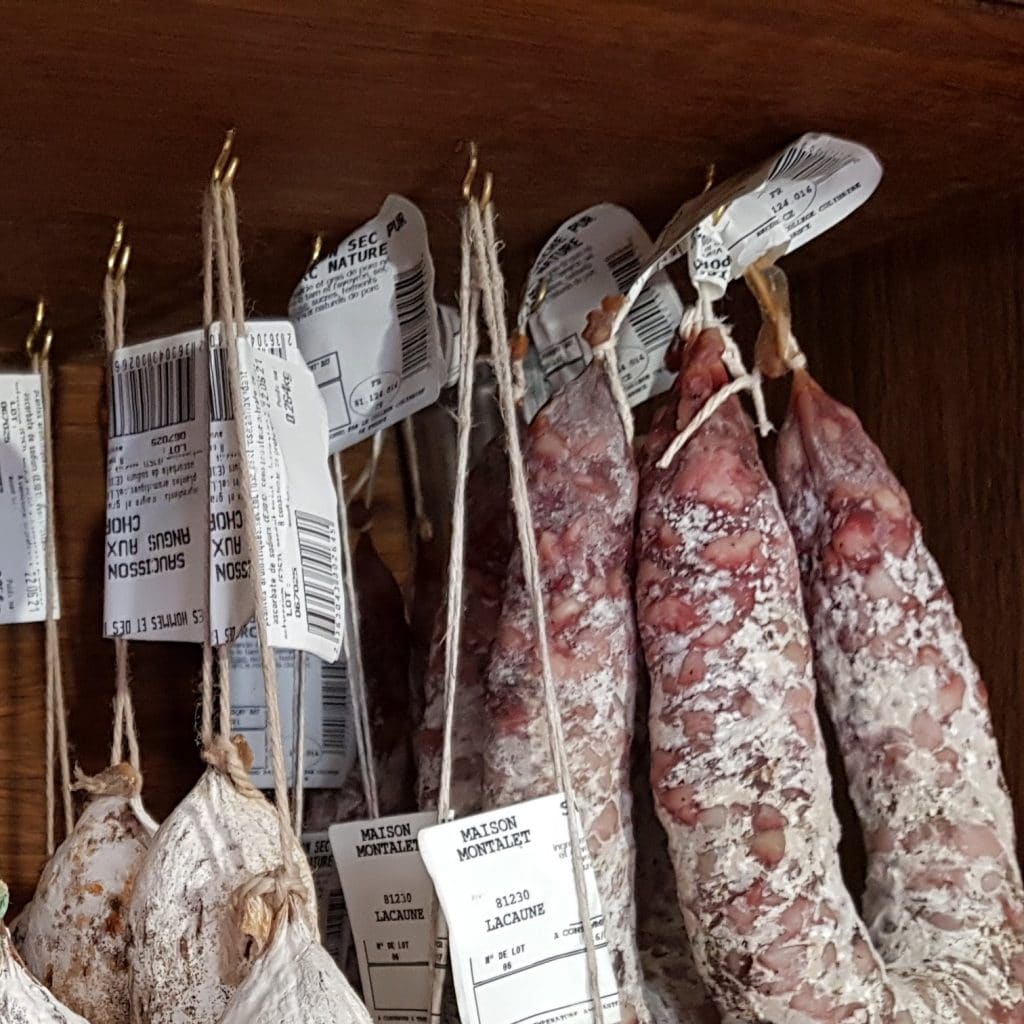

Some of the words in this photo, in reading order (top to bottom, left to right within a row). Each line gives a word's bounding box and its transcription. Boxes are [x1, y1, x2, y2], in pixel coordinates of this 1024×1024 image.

[348, 232, 378, 252] SEC
[386, 211, 407, 238] PUR
[328, 242, 389, 273] NATURE
[167, 443, 187, 456] LOT
[107, 537, 138, 558] AUX
[148, 526, 191, 552] ANGUS
[212, 535, 241, 558] AUX
[108, 552, 186, 580] SAUCISSON
[285, 592, 293, 618] LOT
[137, 617, 147, 634] ET
[151, 610, 188, 631] HOMMES
[192, 608, 205, 625] ES
[112, 620, 131, 637] DES
[360, 823, 412, 842] MAISON
[460, 815, 518, 843] MAISON
[356, 838, 419, 858] MONTALET
[456, 829, 532, 862] MONTALET
[383, 893, 412, 905] 81230
[495, 889, 531, 909] 81230
[374, 908, 425, 922] LACAUNE
[485, 902, 546, 933] LACAUNE
[498, 950, 508, 961] DE
[511, 944, 526, 957] LOT
